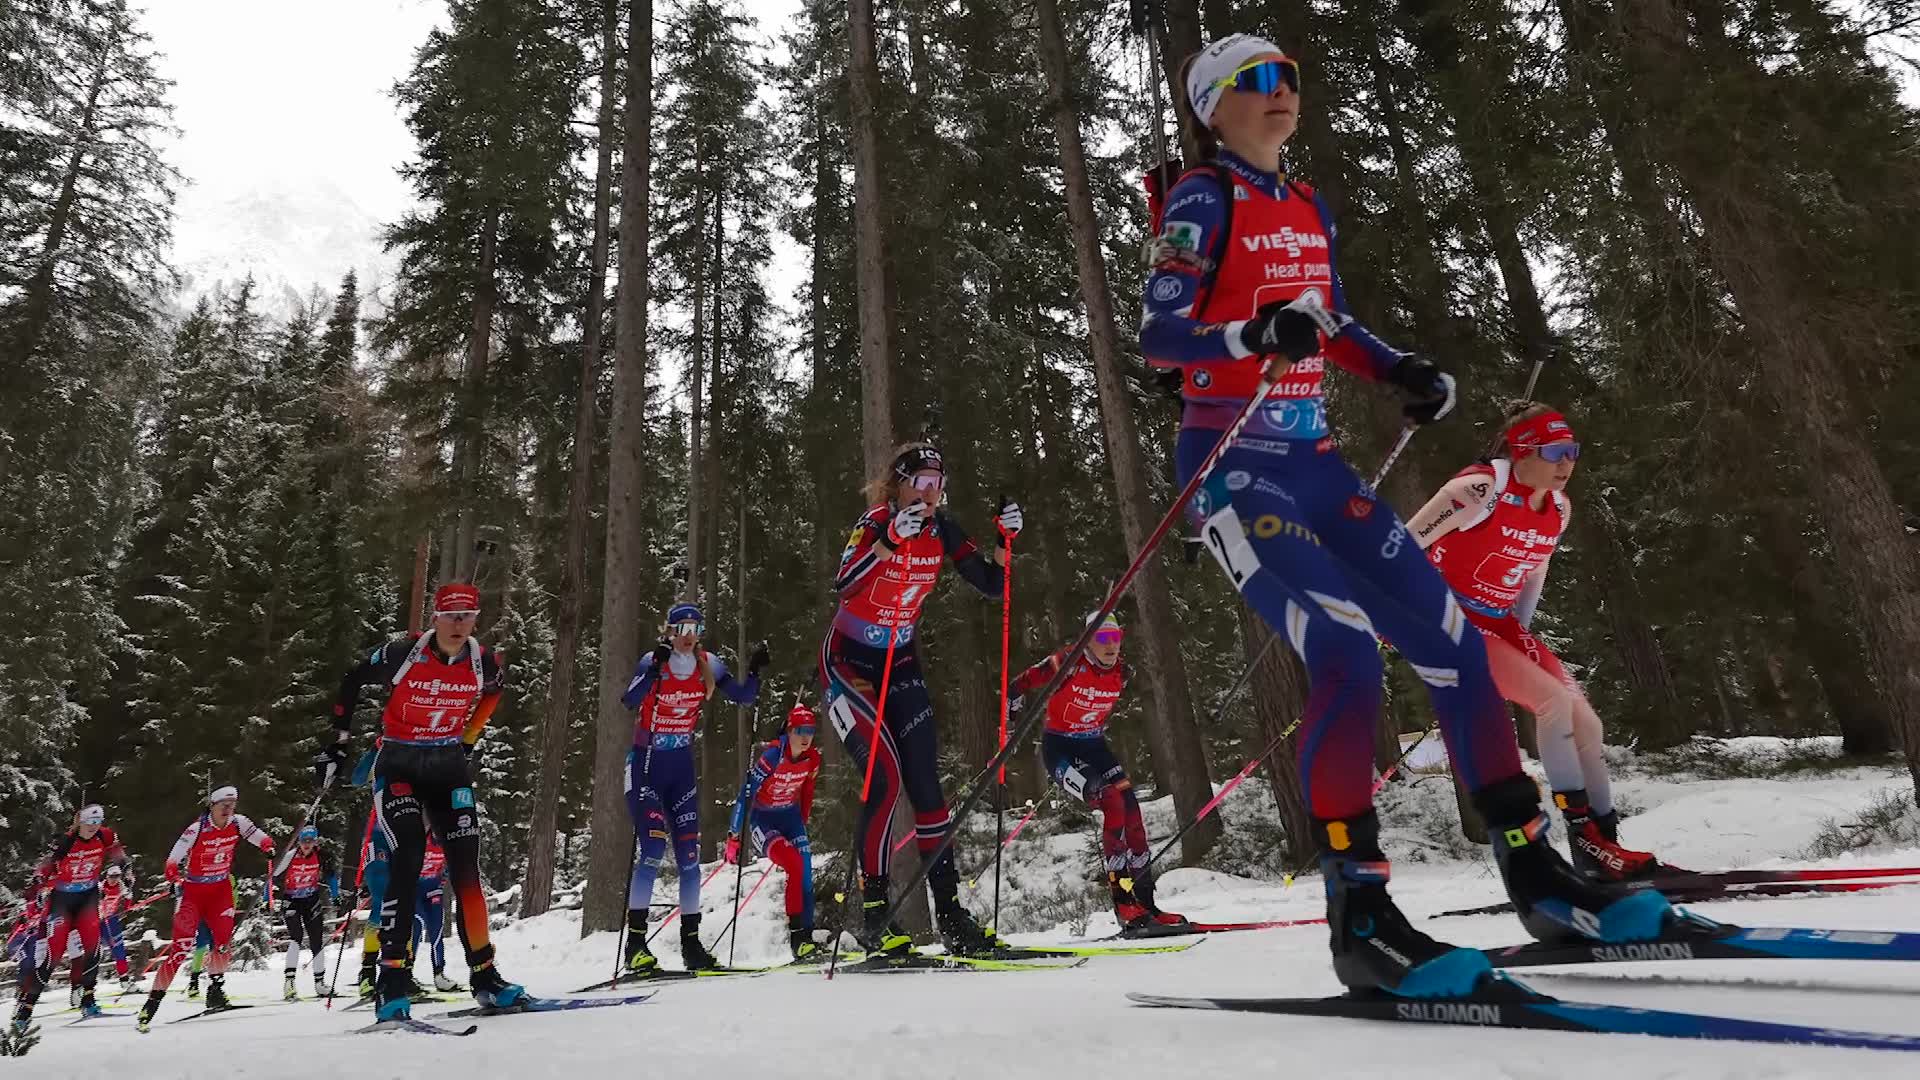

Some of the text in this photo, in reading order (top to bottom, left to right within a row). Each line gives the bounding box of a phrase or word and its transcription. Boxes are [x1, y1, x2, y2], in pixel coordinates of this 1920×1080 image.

[1264, 262, 1301, 279] Heat
[1418, 509, 1454, 538] helvetia
[1208, 525, 1244, 584] 2
[1432, 546, 1447, 564] 5
[1502, 544, 1527, 558] Heat
[1502, 562, 1535, 588] 5
[407, 679, 477, 696] VIESSMANN
[1071, 684, 1121, 701] VIESSMANN
[411, 694, 434, 705] Heat
[1591, 942, 1694, 963] SALOMON
[1397, 1002, 1500, 1025] SALOMON
